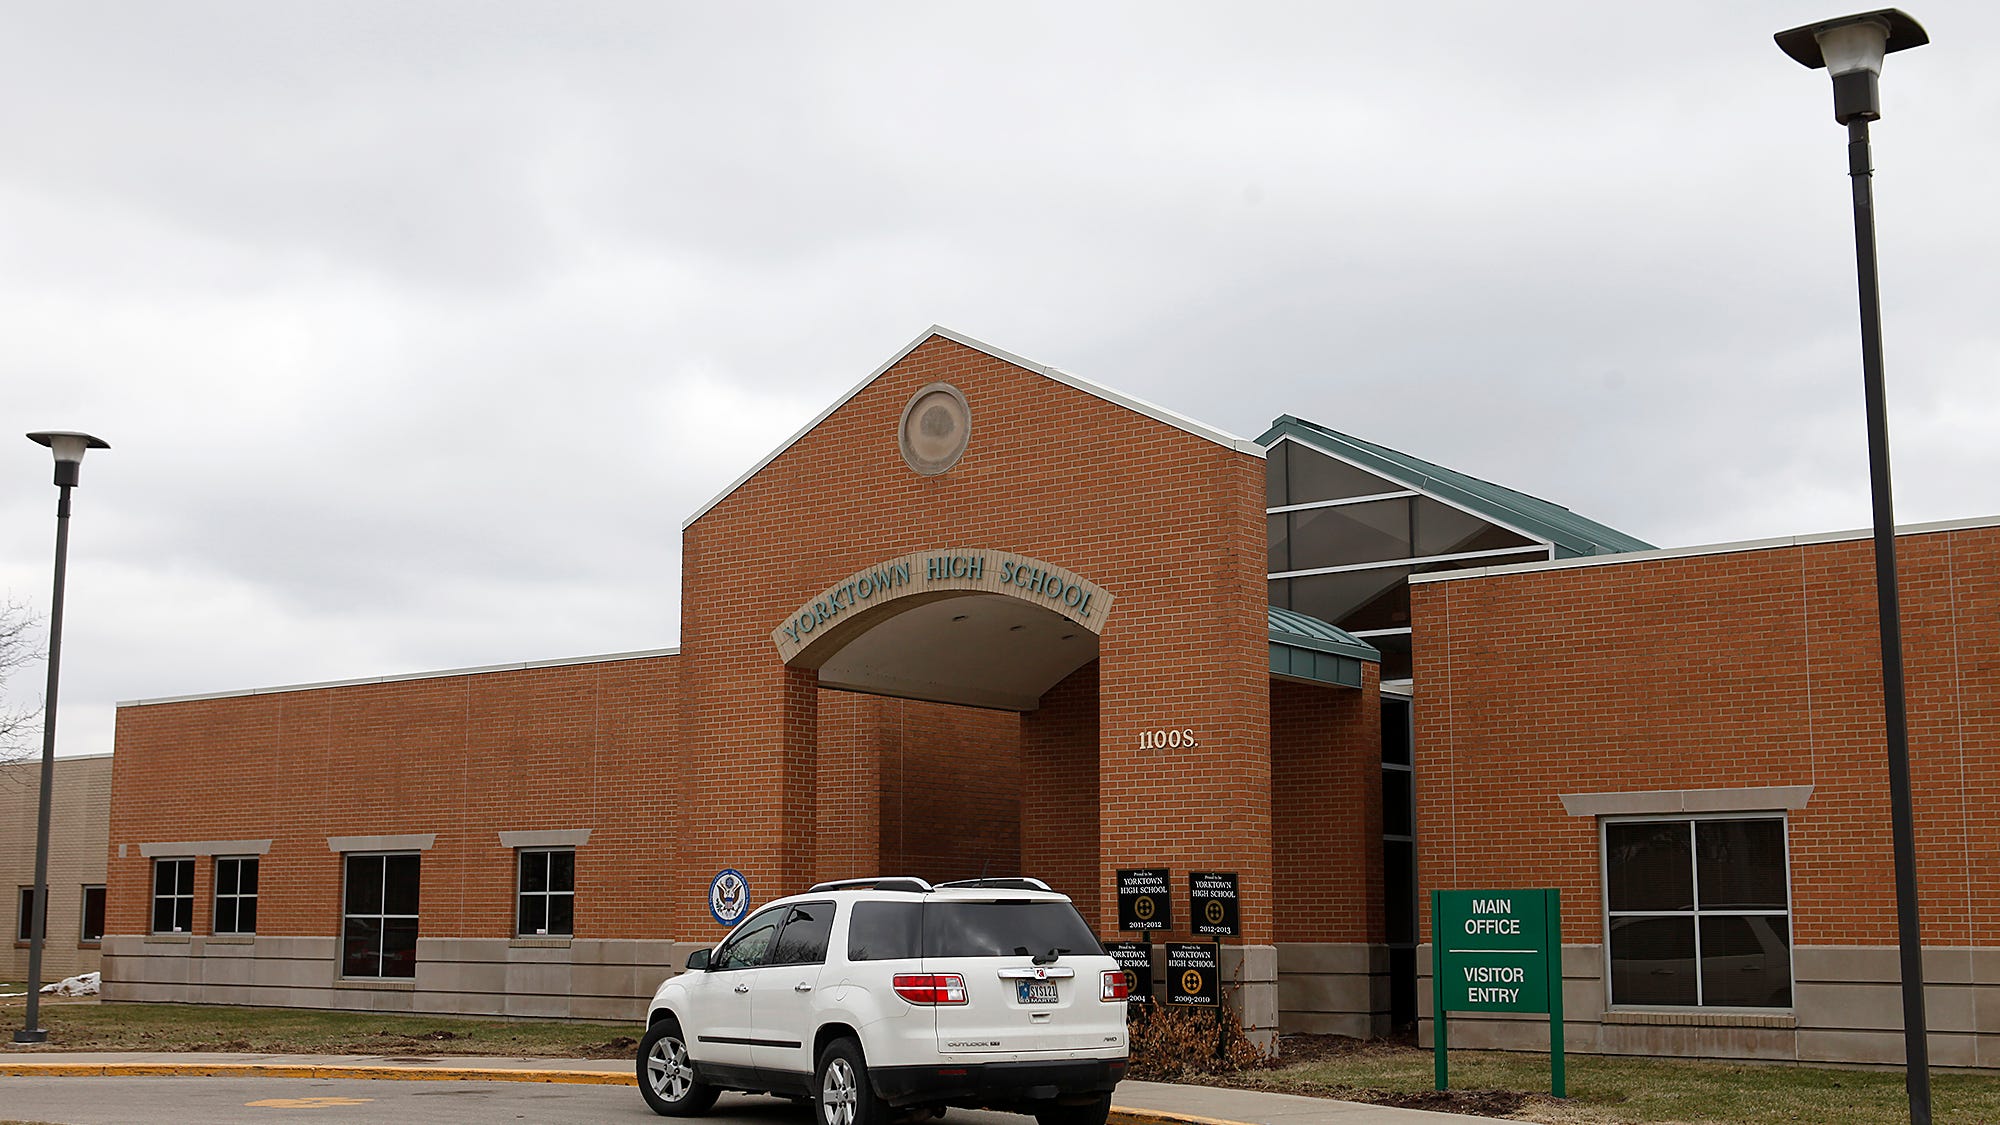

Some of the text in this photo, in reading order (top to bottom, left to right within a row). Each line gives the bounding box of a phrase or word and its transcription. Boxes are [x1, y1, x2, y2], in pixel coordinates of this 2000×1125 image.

[783, 556, 1092, 644] YORKTOWN HIGH SCHOOL
[1123, 876, 1163, 886] YORKTOWN
[1195, 880, 1232, 889] YORKTOWN
[1120, 885, 1168, 895] HIGH SCHOOL
[1192, 889, 1236, 899] HIGH SCHOOL
[1472, 899, 1511, 914] MAIN
[1128, 921, 1162, 929] 2011-2012
[1464, 919, 1520, 934] OFFICE
[1199, 926, 1231, 934] 2012-2013
[1108, 950, 1146, 958] YORKTOWN
[1171, 950, 1211, 959] YORKTOWN
[1123, 959, 1150, 968] SCHOOL
[1168, 959, 1216, 968] HIGH SCHOOL
[1463, 967, 1524, 983] VISITOR
[1127, 994, 1146, 1003] -2004
[1174, 995, 1210, 1003] 2009-2010
[1468, 987, 1520, 1003] ENTRY
